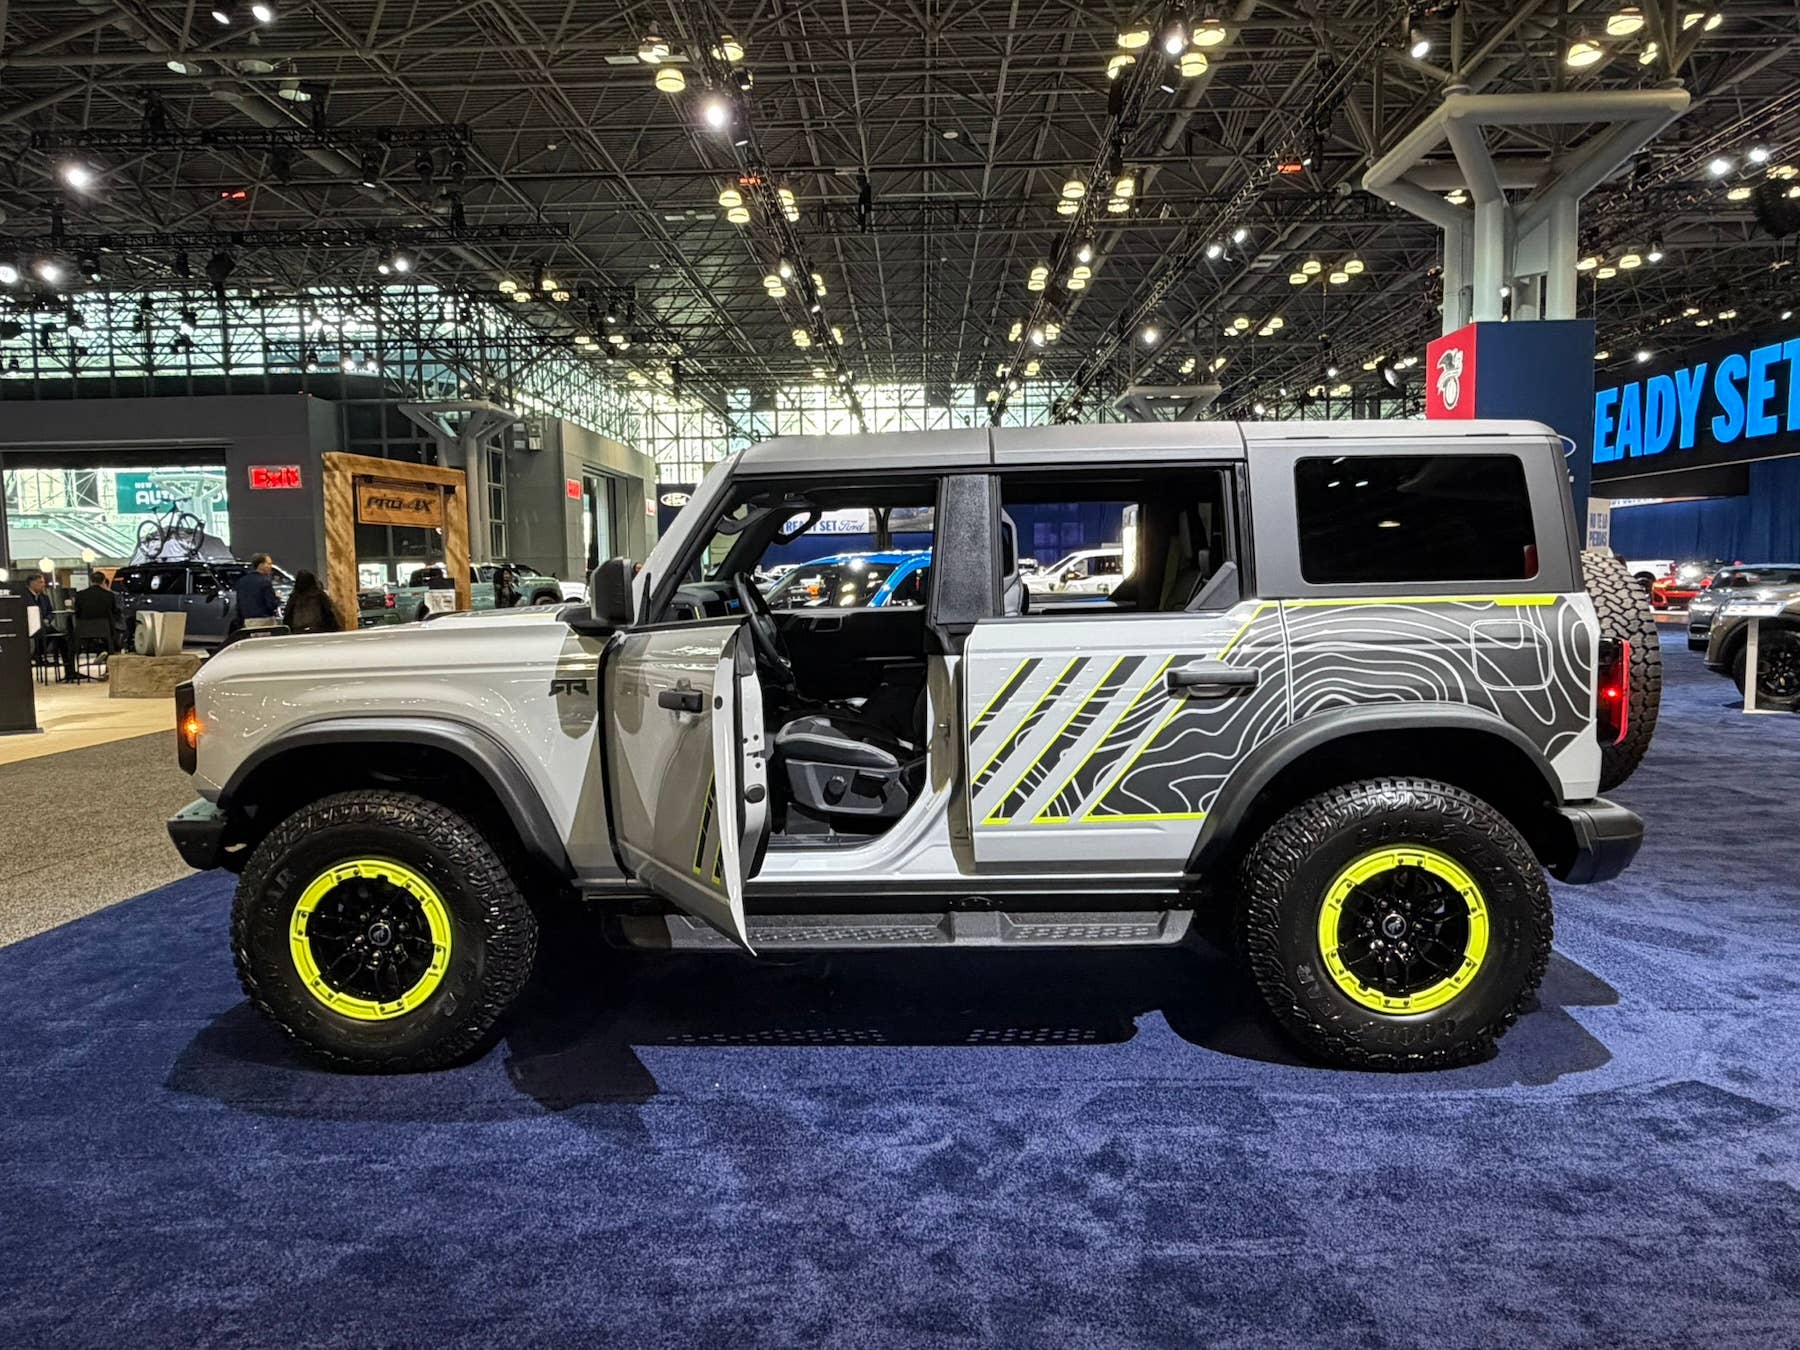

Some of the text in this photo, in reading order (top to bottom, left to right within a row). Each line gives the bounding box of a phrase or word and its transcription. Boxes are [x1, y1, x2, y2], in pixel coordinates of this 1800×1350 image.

[251, 467, 299, 487] Exit
[820, 520, 838, 532] SET
[839, 520, 865, 532] Ford
